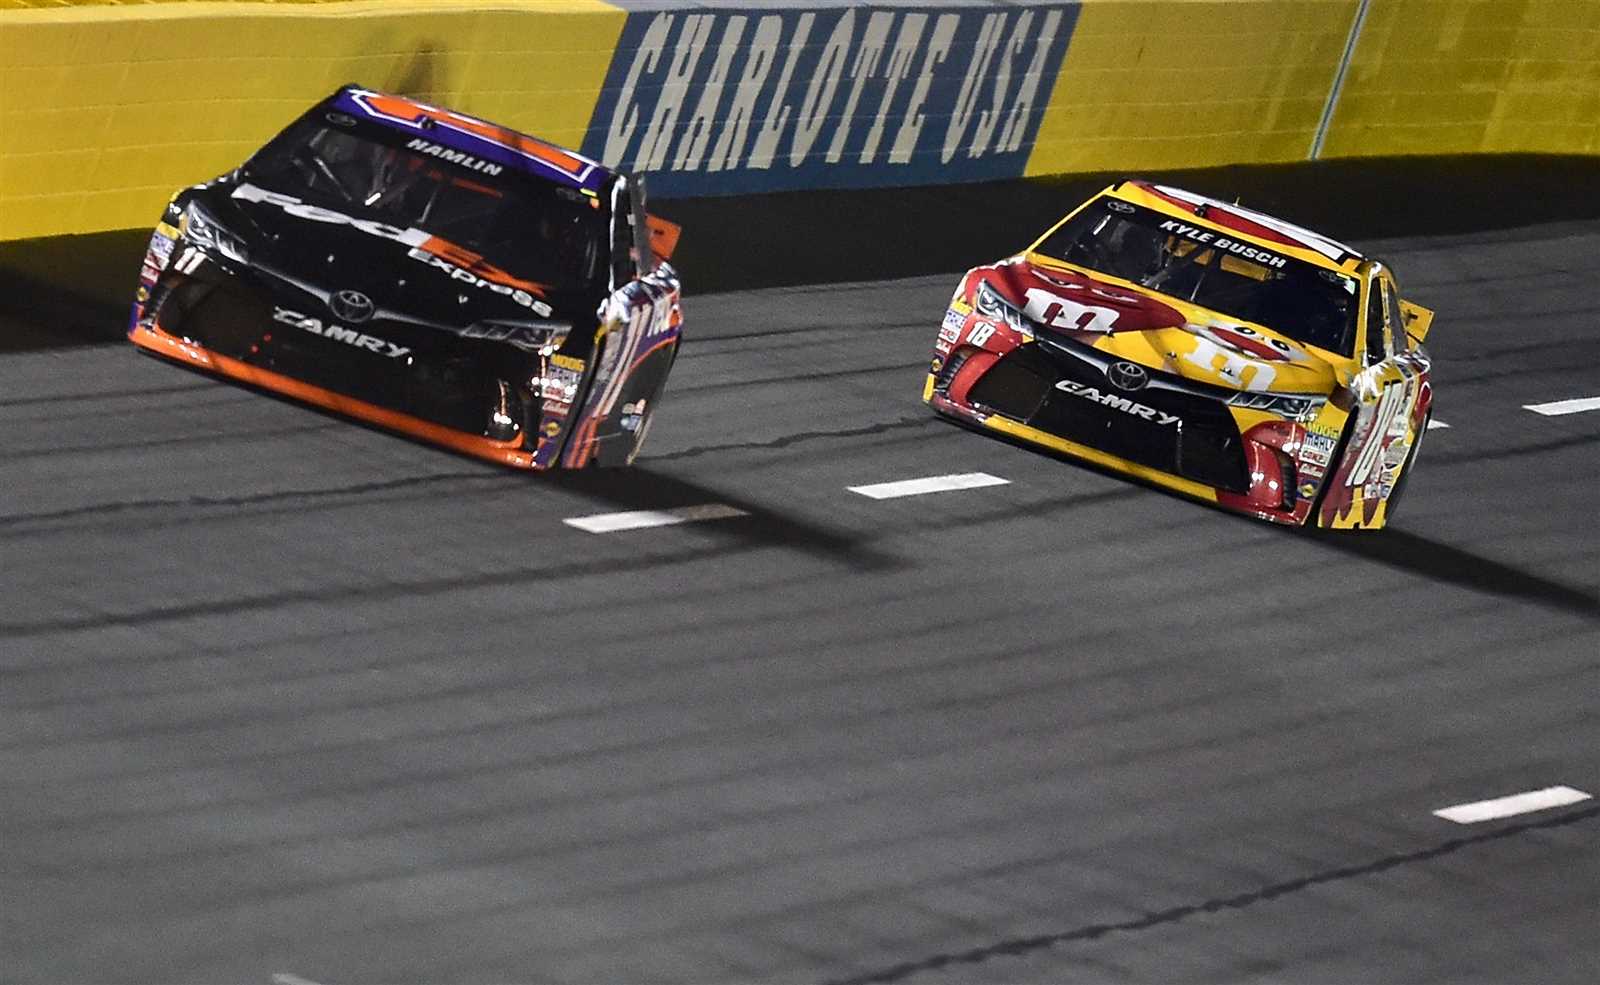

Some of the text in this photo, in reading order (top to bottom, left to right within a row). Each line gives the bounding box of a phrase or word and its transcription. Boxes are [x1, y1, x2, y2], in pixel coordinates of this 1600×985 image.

[602, 8, 1062, 172] CHARLOTTE USA
[405, 138, 503, 177] HAMLIN
[174, 246, 207, 275] 11
[1160, 220, 1287, 269] KYLE BUSCH
[407, 247, 553, 318] Express
[273, 306, 411, 358] CAMRY
[1024, 287, 1121, 333] m
[966, 321, 996, 347] 18
[1055, 380, 1179, 425] CAMRY
[1345, 382, 1403, 487] 18
